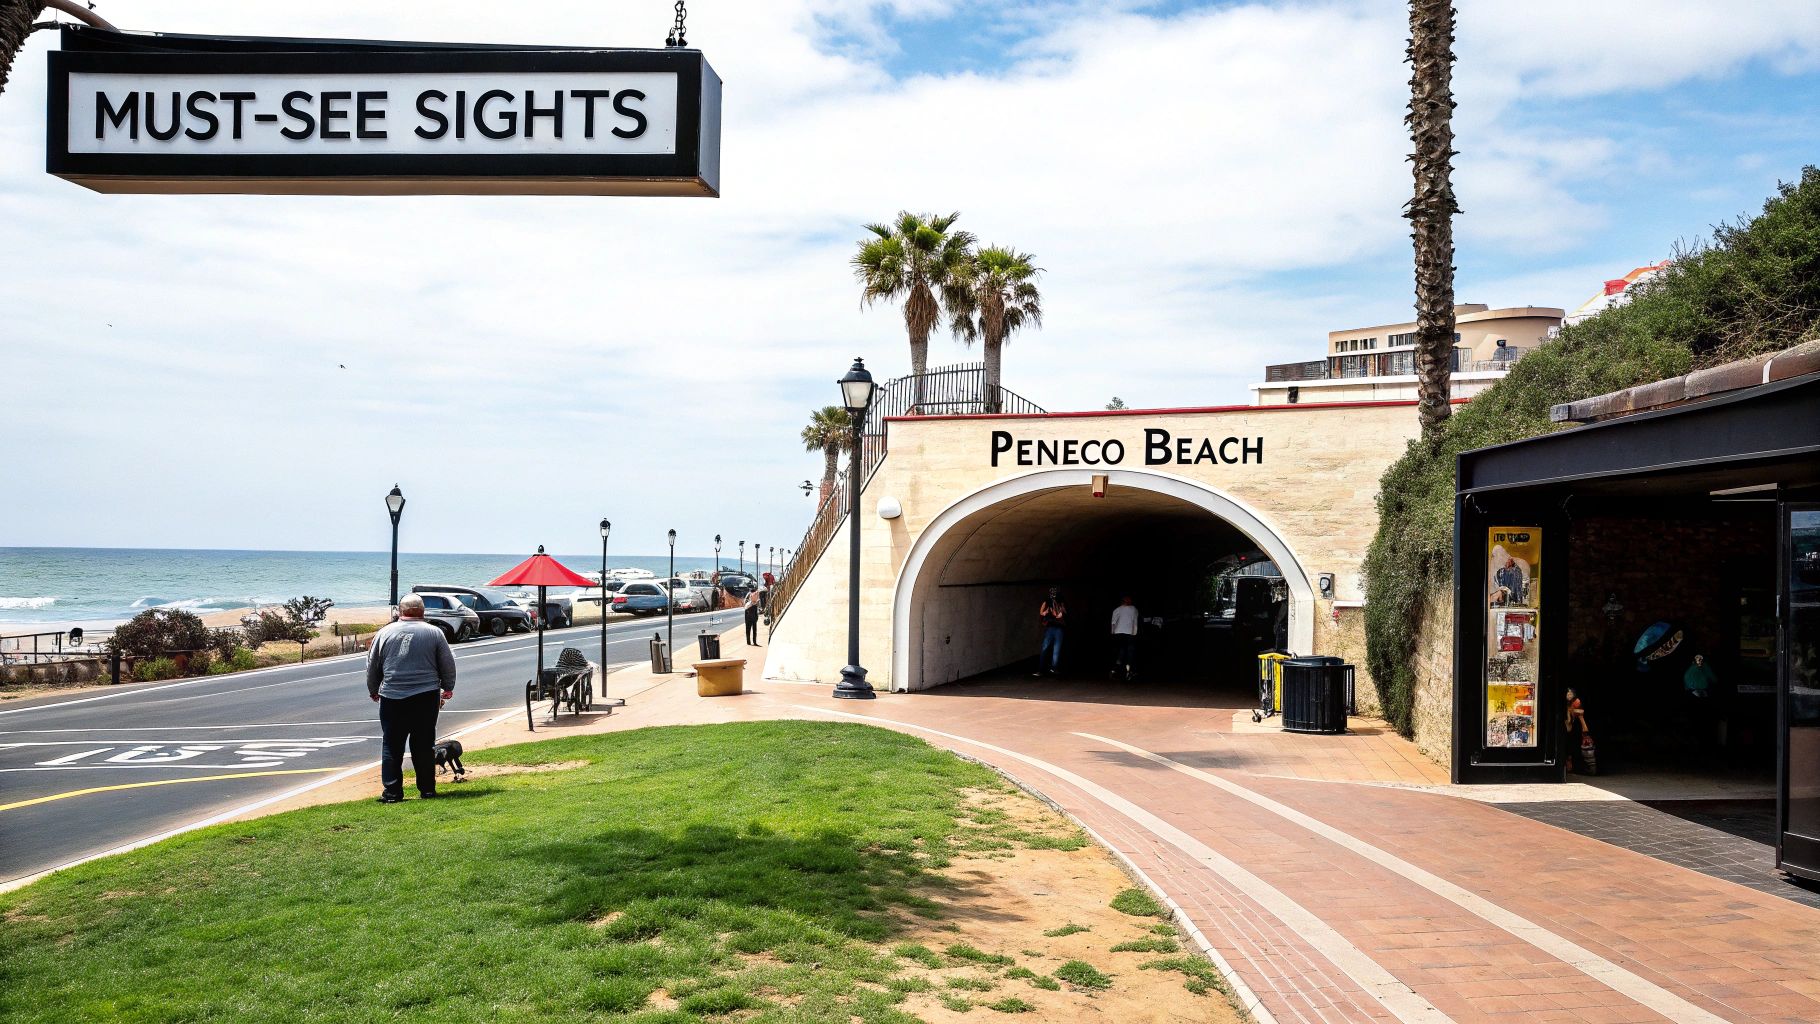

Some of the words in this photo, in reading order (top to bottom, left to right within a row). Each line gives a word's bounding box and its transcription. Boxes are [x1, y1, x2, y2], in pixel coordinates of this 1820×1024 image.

[96, 91, 388, 142] MUST-SEE
[414, 89, 648, 140] SIGHTS
[1143, 428, 1264, 466] BEACH
